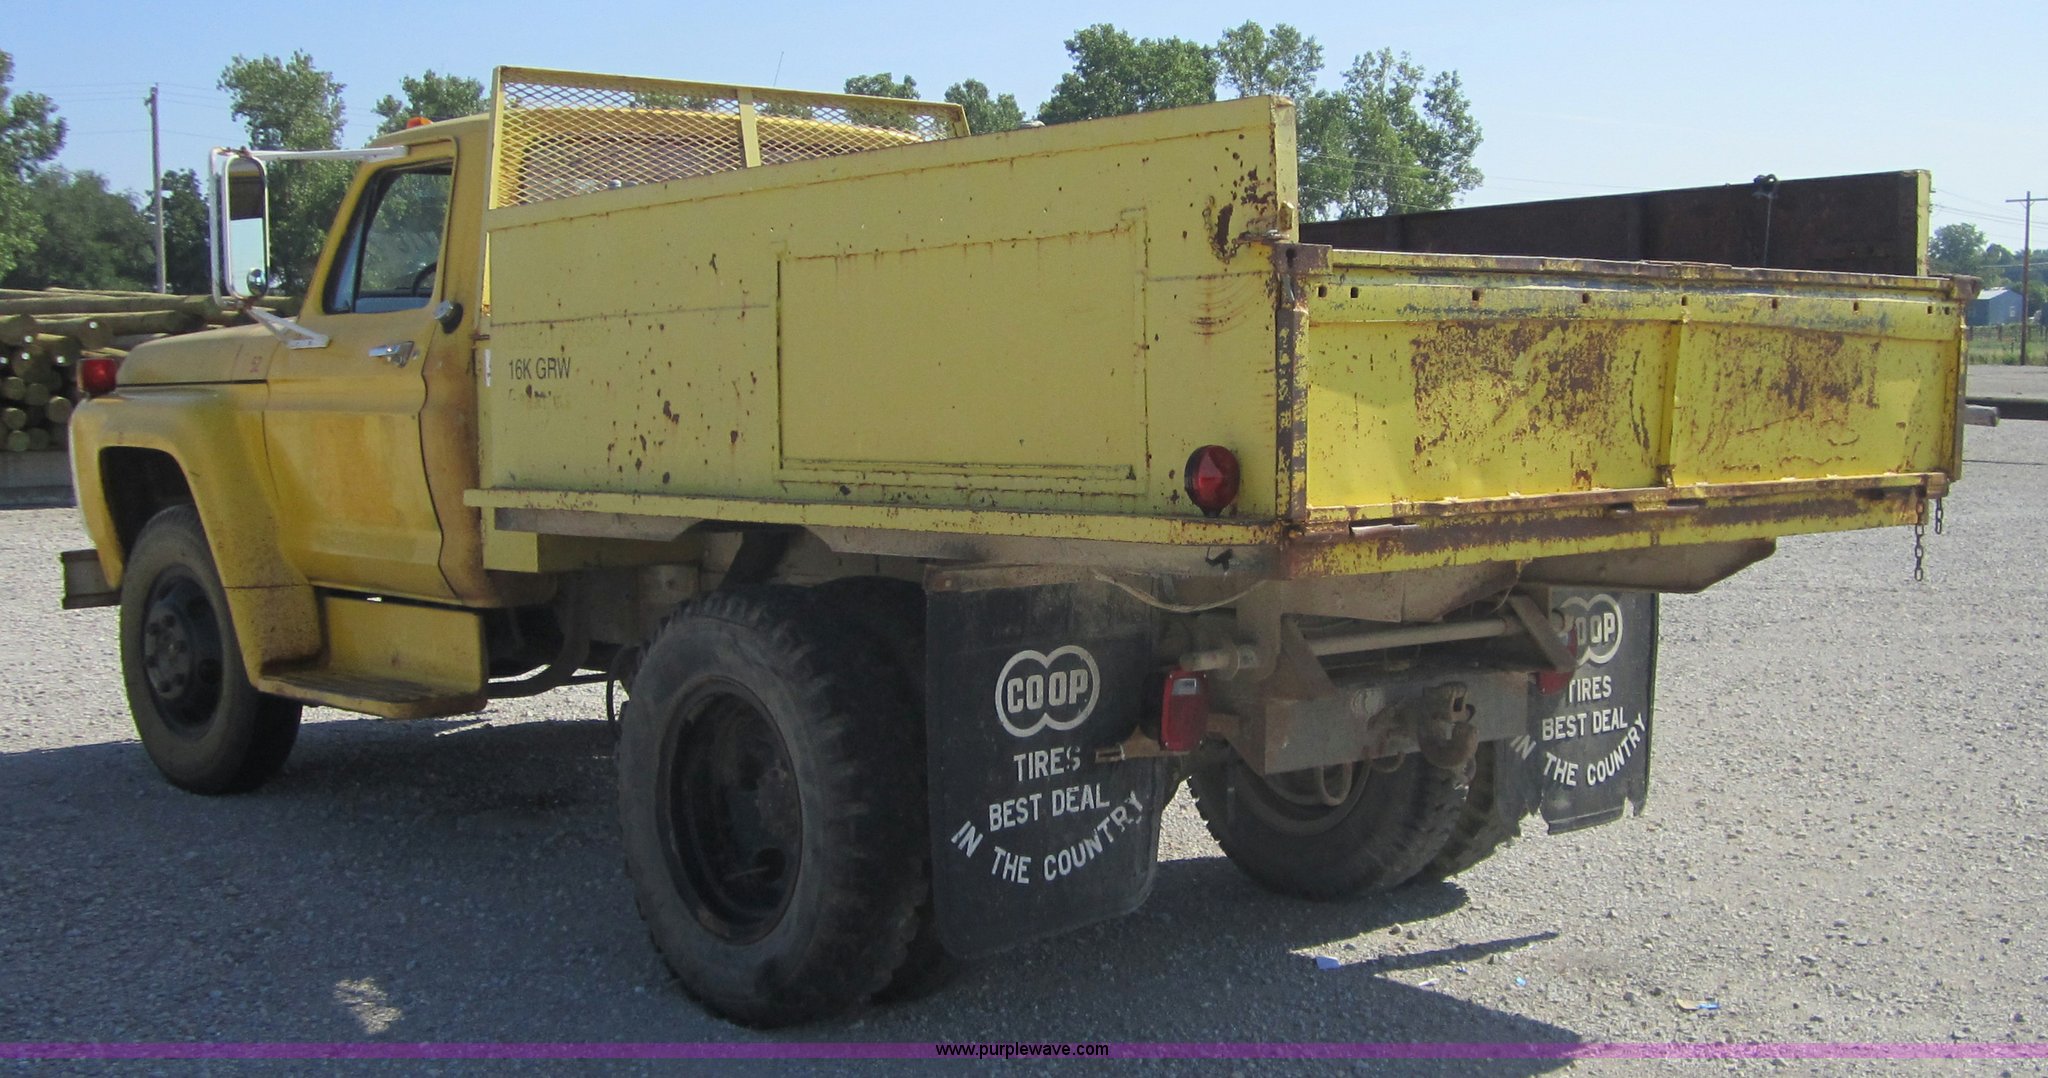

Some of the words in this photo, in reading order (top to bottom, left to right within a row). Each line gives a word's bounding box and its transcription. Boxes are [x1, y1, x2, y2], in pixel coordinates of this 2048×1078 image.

[509, 358, 532, 380] 16K
[536, 357, 571, 379] GRW
[1575, 612, 1616, 646] OOP
[1007, 669, 1088, 713] COOP
[1569, 675, 1612, 703] TIRES
[1542, 713, 1587, 741] BEST
[1593, 706, 1628, 734] DEAL
[1013, 746, 1081, 782] TIRES
[1511, 734, 1537, 760] IN
[1543, 751, 1579, 787] THE
[1587, 712, 1647, 786] COUNTRY
[989, 793, 1042, 832] BEST
[1052, 783, 1110, 817] DEAL
[951, 820, 984, 858] IN
[991, 846, 1032, 884] THE
[1043, 790, 1143, 882] COUNTRY
